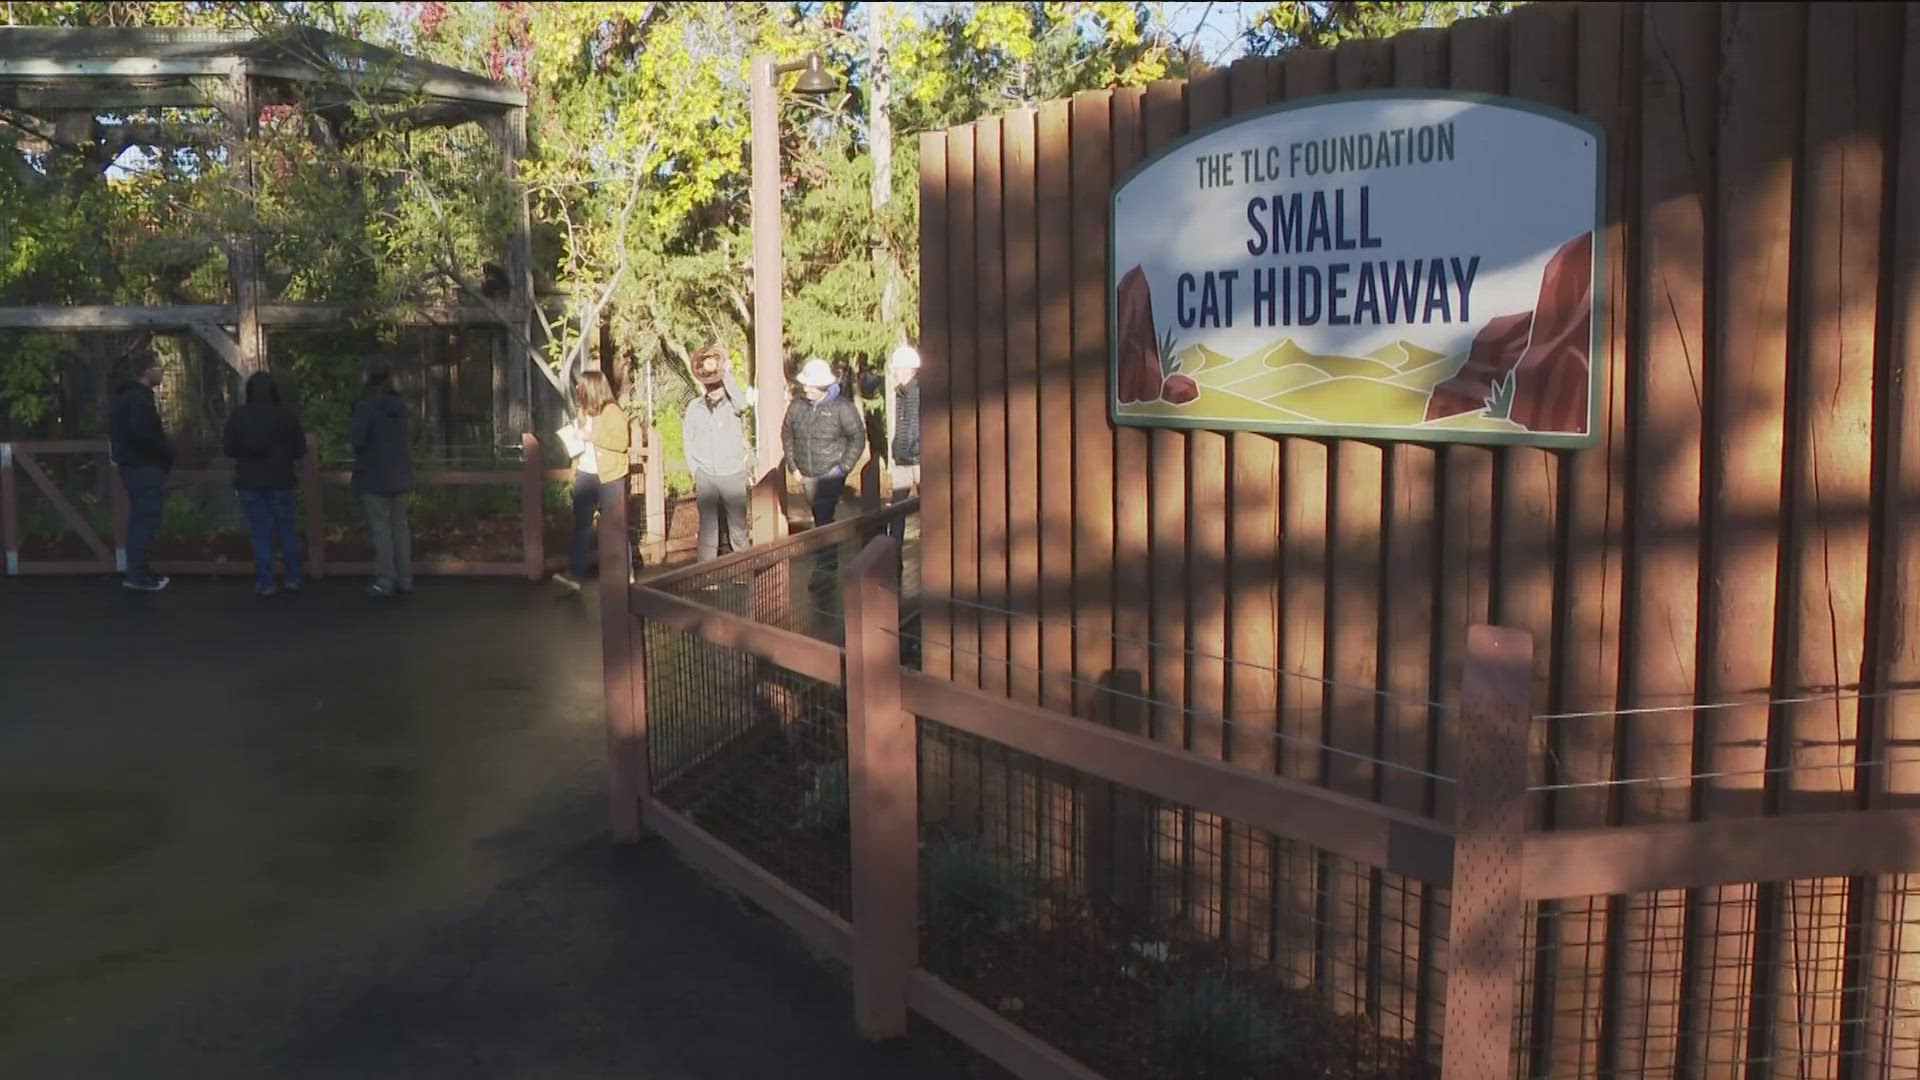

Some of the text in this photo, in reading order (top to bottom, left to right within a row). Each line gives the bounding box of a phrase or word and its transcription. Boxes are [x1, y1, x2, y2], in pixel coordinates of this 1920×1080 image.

[1196, 122, 1455, 189] THE TLC FOUNDATION
[1246, 185, 1382, 257] SMALL
[1176, 256, 1481, 329] CAT HIDEAWAY
